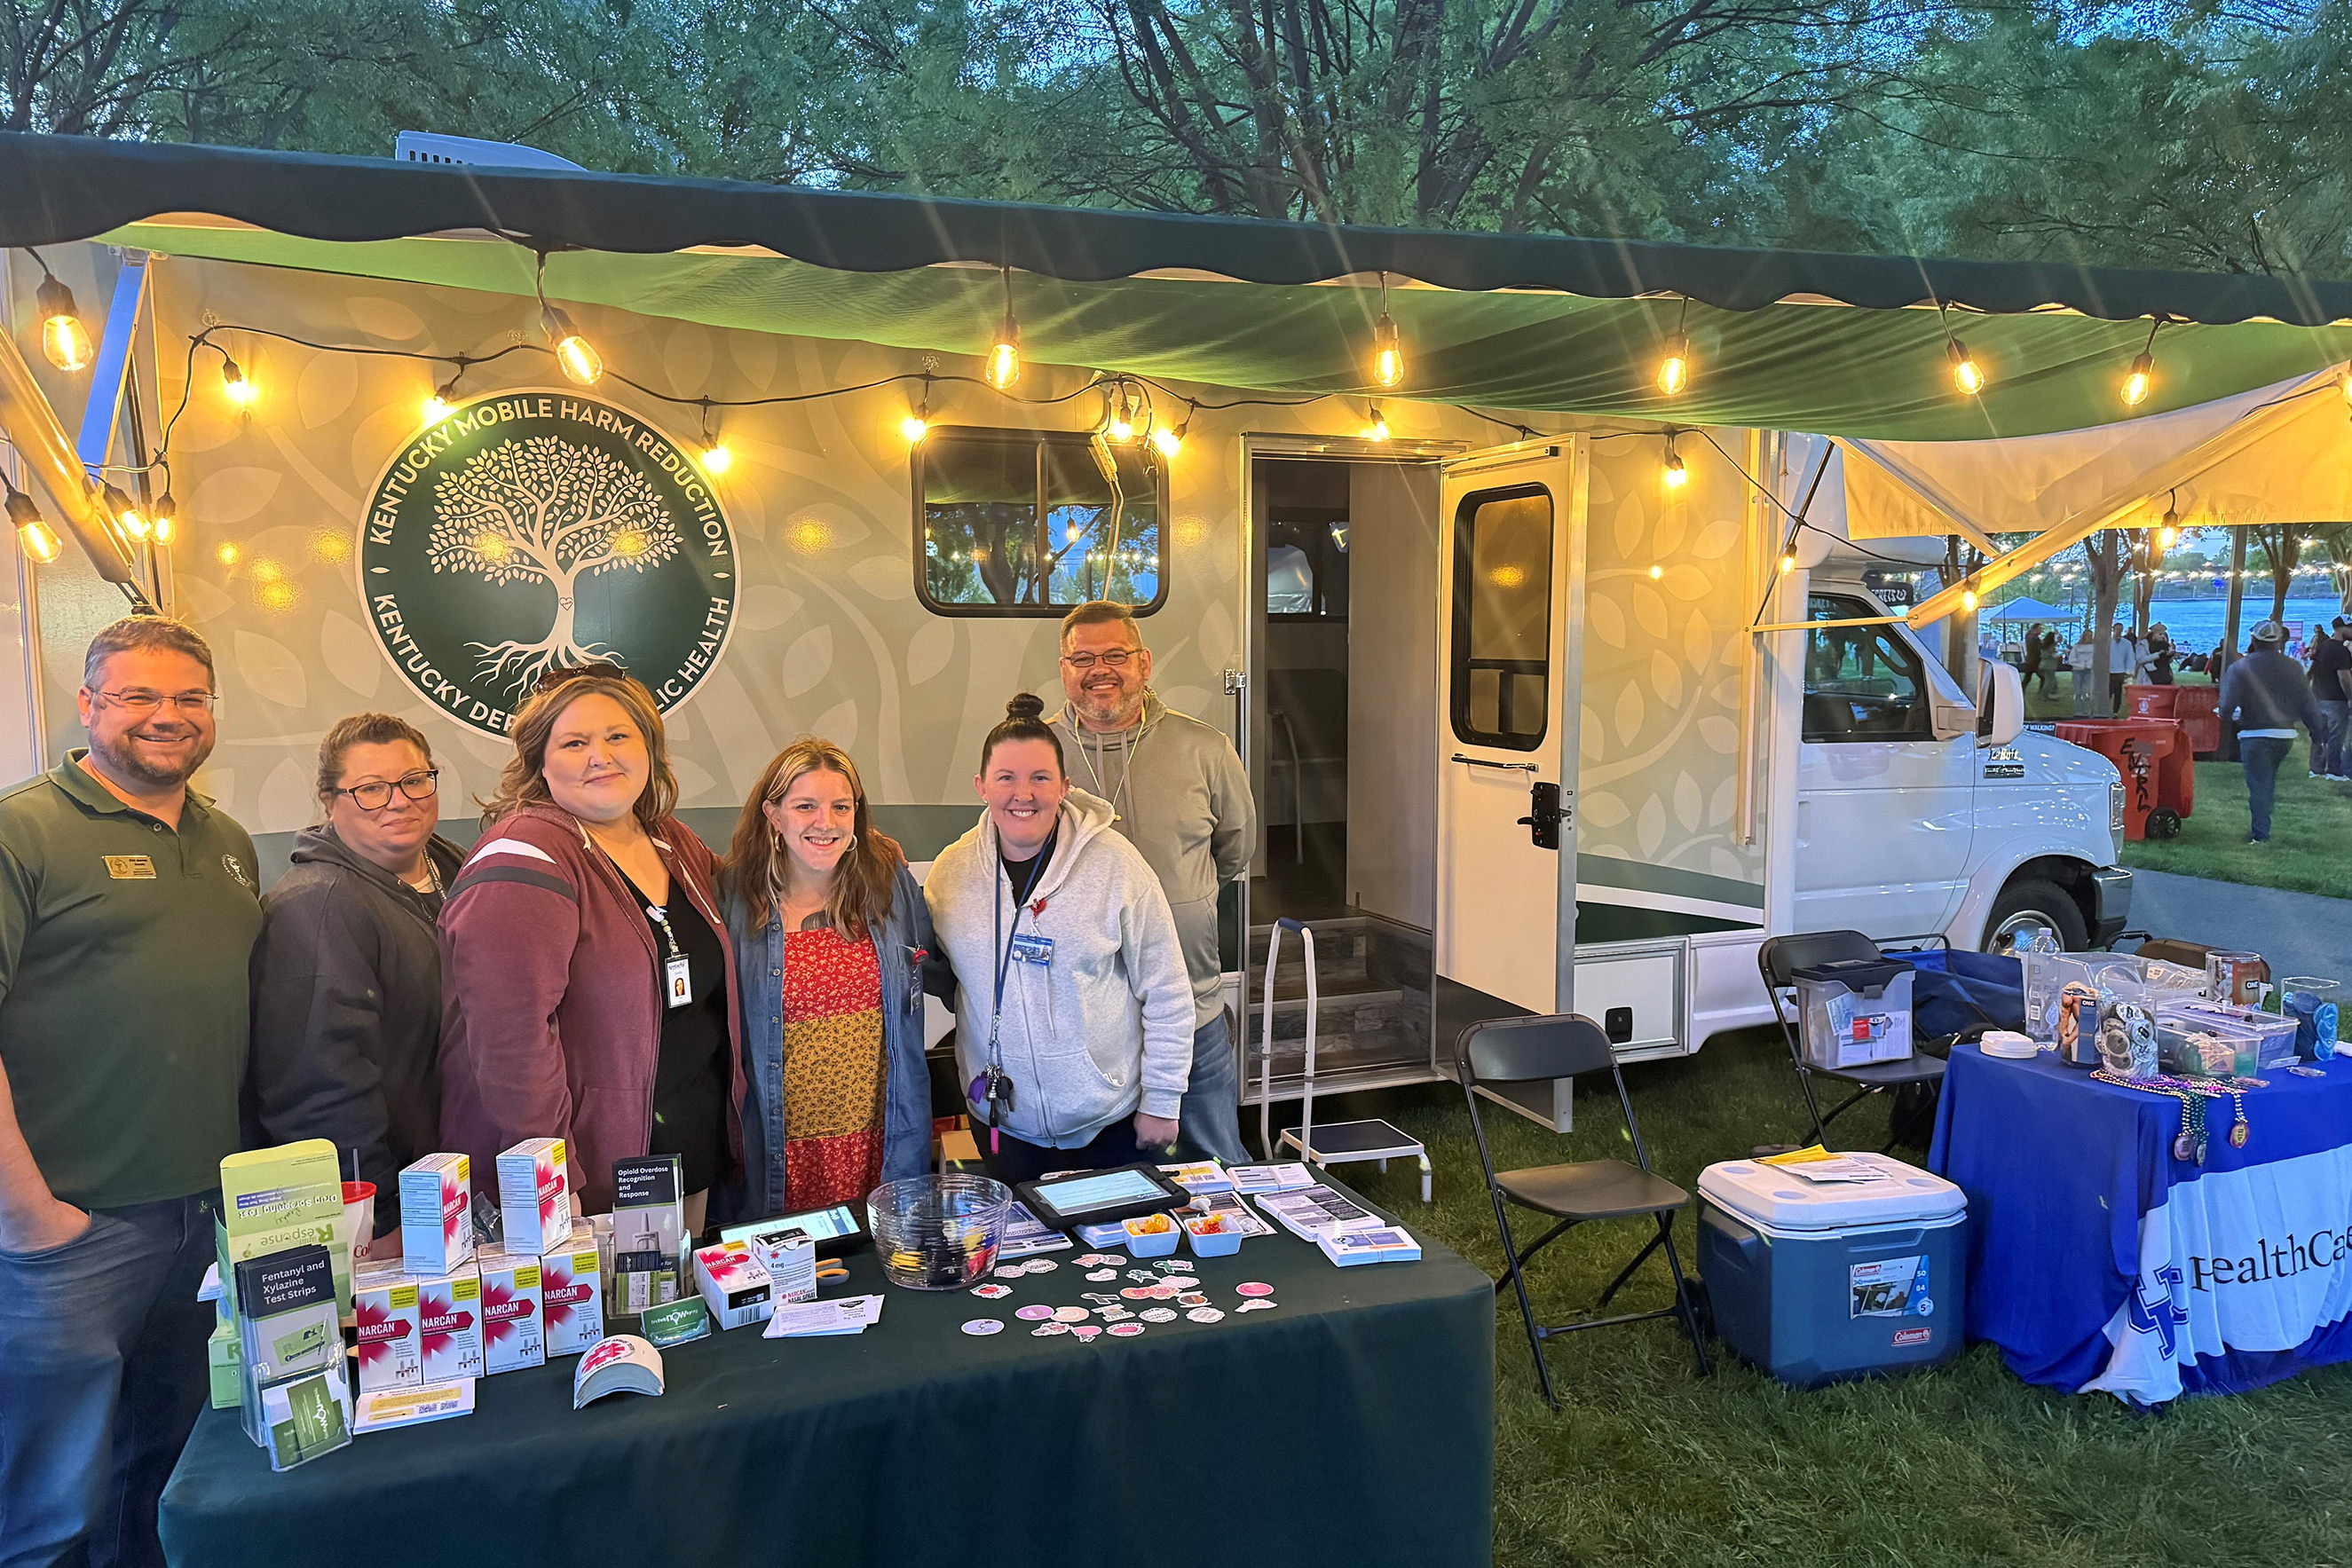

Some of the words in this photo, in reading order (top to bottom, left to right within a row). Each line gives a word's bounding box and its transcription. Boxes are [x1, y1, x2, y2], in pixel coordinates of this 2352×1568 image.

[370, 426, 454, 544] KENTUCKY
[454, 398, 554, 437] MOBILE
[559, 400, 635, 440] HARM
[635, 435, 728, 556] REDUCTION
[373, 594, 471, 709] KENTUCKY
[655, 678, 683, 710] LIC
[677, 596, 730, 683] HEALTH
[618, 1168, 639, 1177] Opioid
[619, 1175, 655, 1184] Recognition
[538, 1178, 557, 1197] NARCAN
[444, 1195, 462, 1214] NARCAN
[706, 1256, 737, 1268] NARCAN
[262, 1265, 305, 1282] Fentanyl
[306, 1260, 325, 1272] and
[263, 1278, 304, 1294] Xylazine
[788, 1289, 806, 1298] NARCAN
[264, 1294, 286, 1305] Test
[288, 1286, 317, 1299] Strips
[544, 1287, 578, 1301] NARCAN
[485, 1301, 519, 1316] NARCAN
[422, 1313, 458, 1329] NARCAN
[359, 1322, 395, 1337] NARCAN
[1894, 1331, 1922, 1342] Coleman
